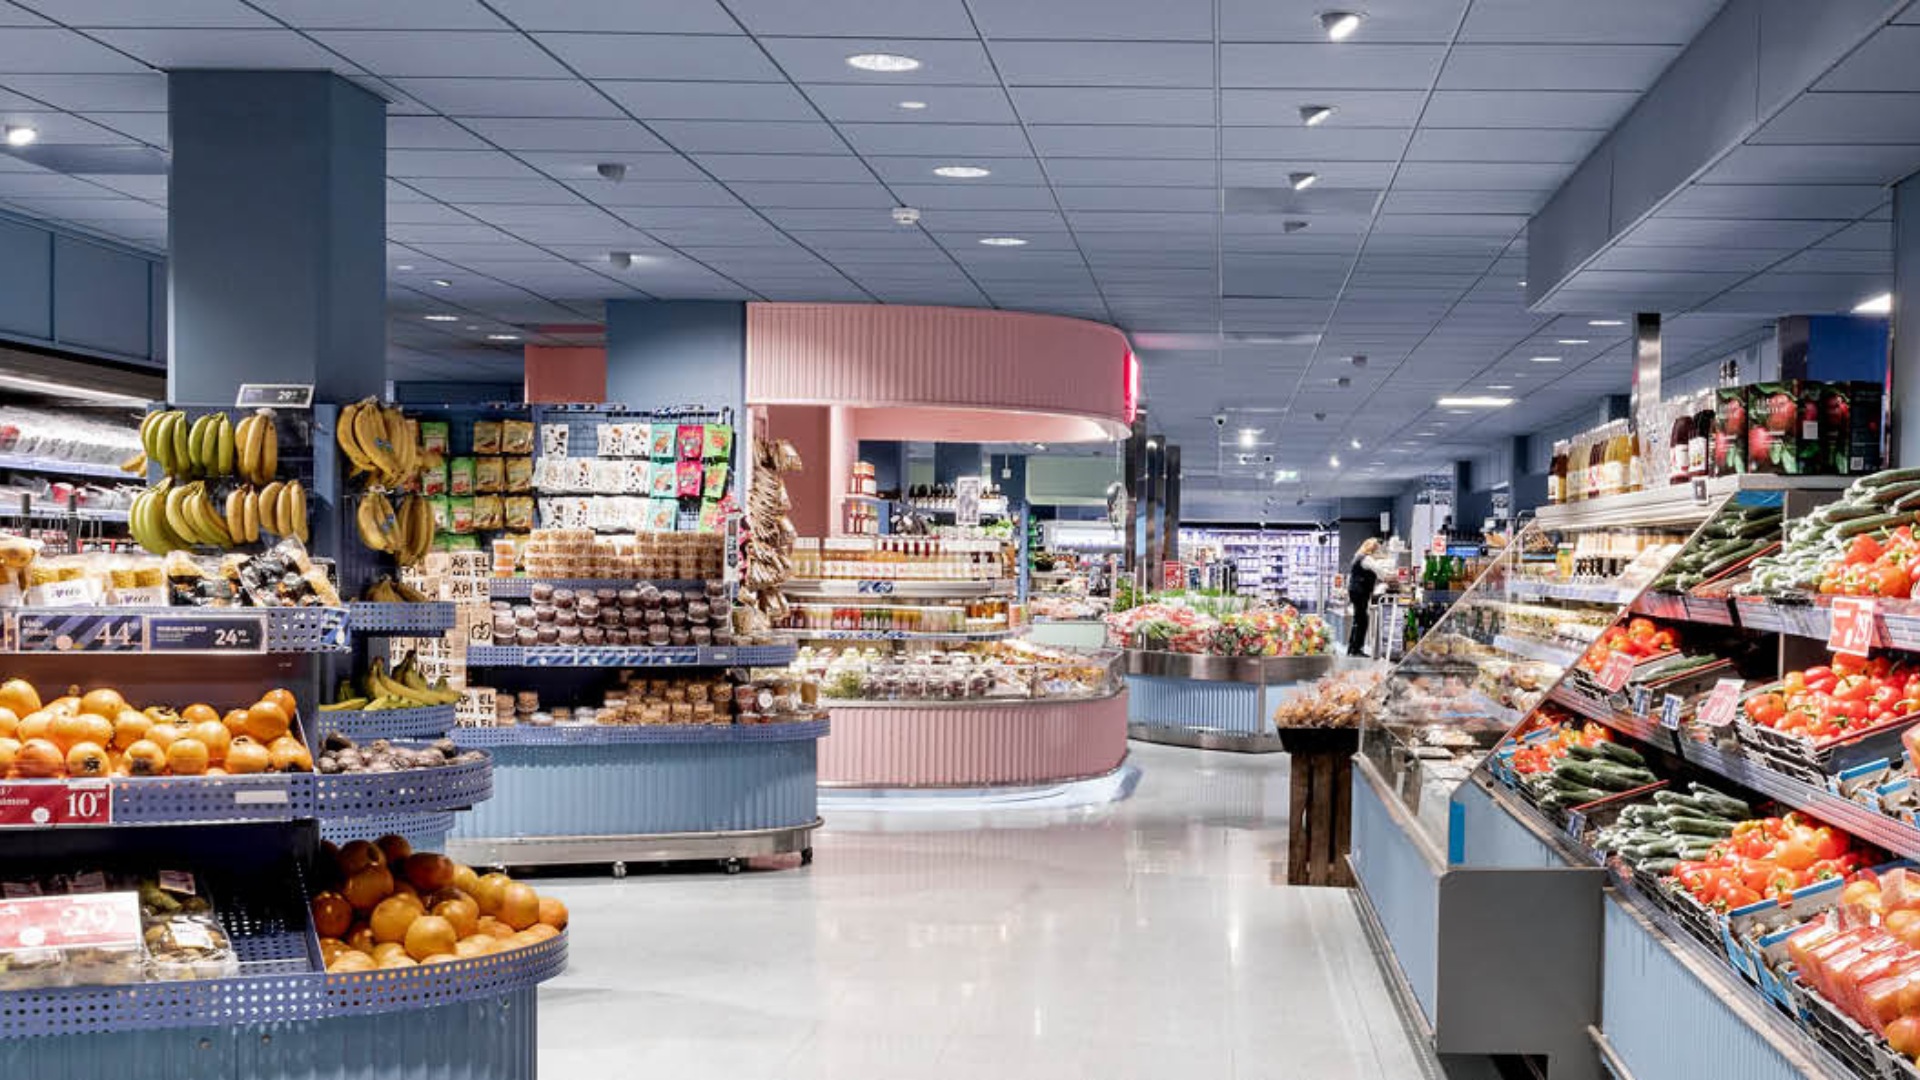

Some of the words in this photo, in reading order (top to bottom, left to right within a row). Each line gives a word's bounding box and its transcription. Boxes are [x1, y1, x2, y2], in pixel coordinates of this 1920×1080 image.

[94, 621, 131, 646] 44
[215, 628, 238, 646] 24
[67, 791, 97, 817] 10
[60, 904, 118, 936] 29
